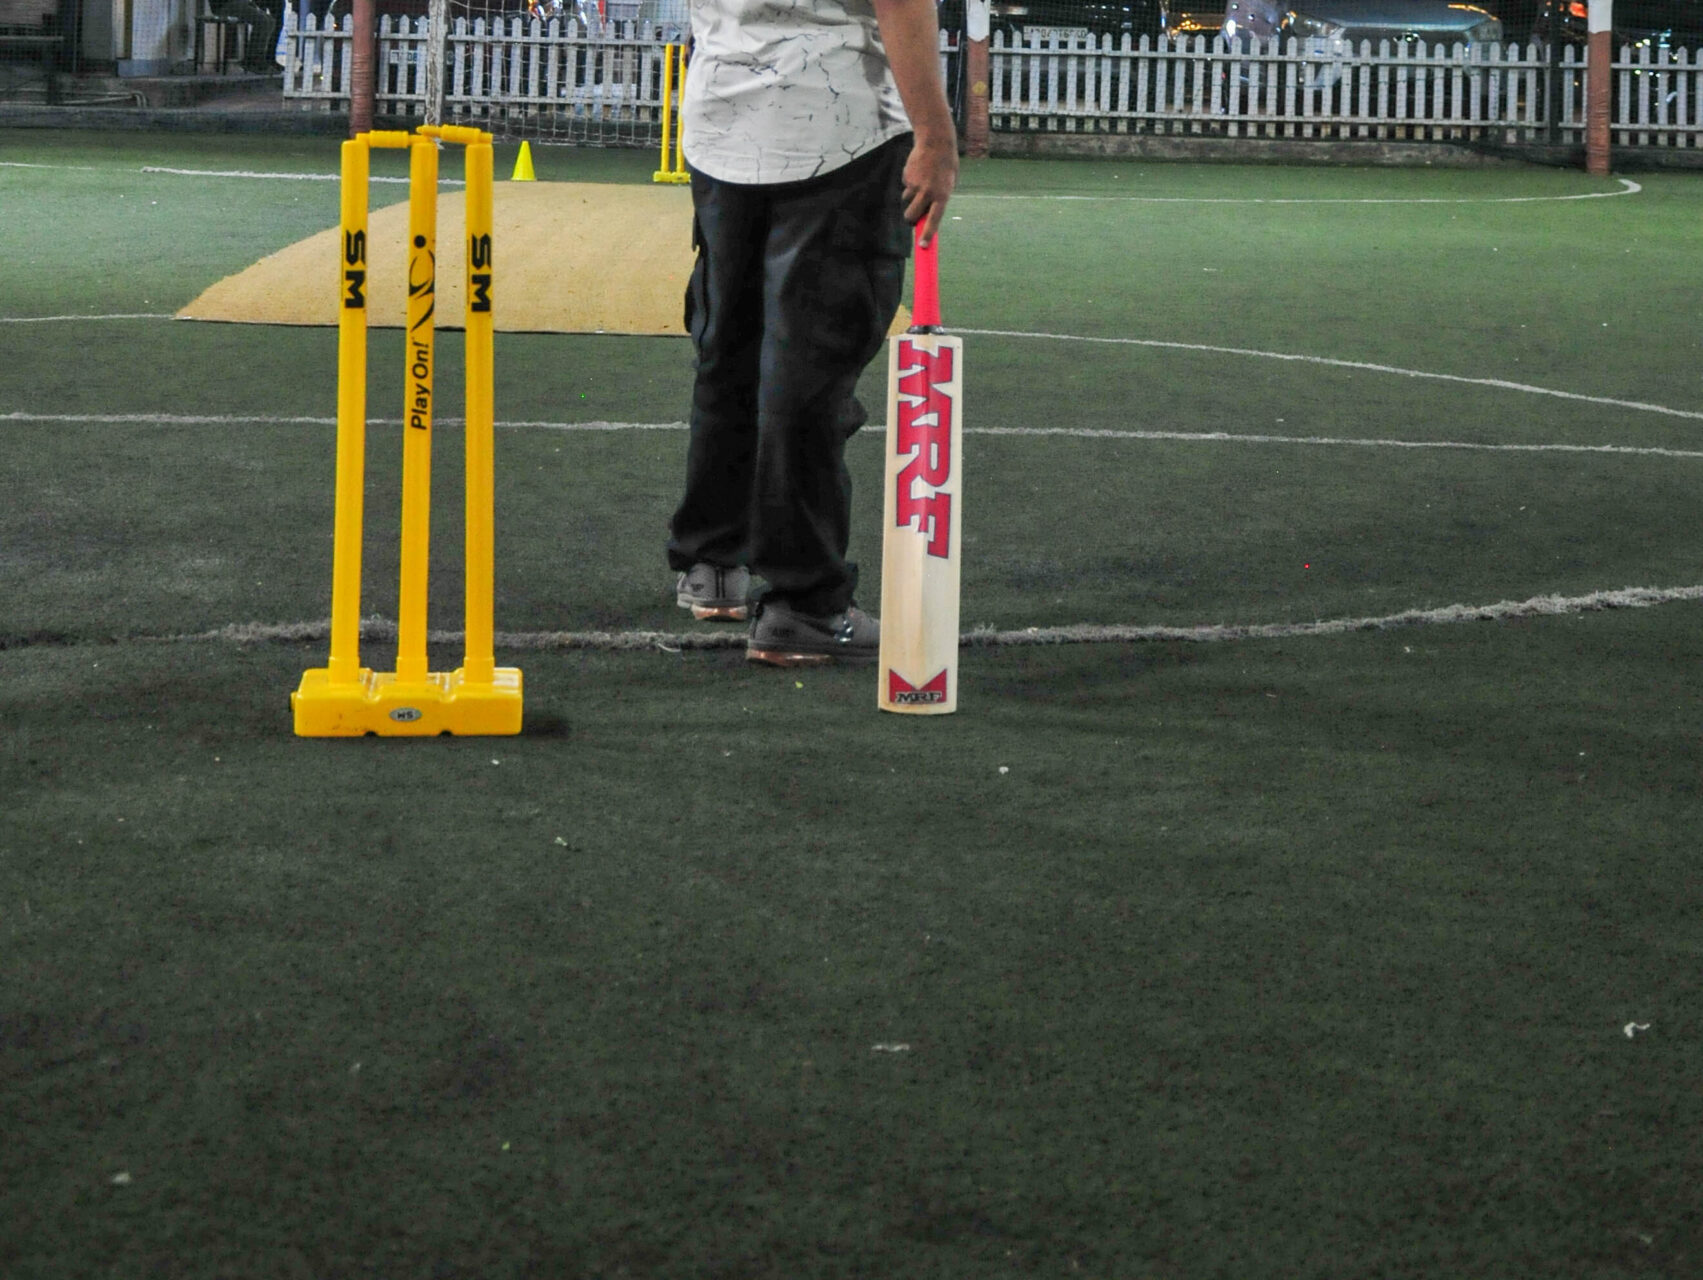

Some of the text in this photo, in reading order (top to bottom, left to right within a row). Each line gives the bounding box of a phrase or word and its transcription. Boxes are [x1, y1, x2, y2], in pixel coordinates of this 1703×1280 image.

[345, 229, 366, 309] SM
[471, 233, 492, 313] SM
[411, 340, 431, 430] Play On!
[896, 339, 954, 559] MRF
[896, 692, 942, 703] MRF
